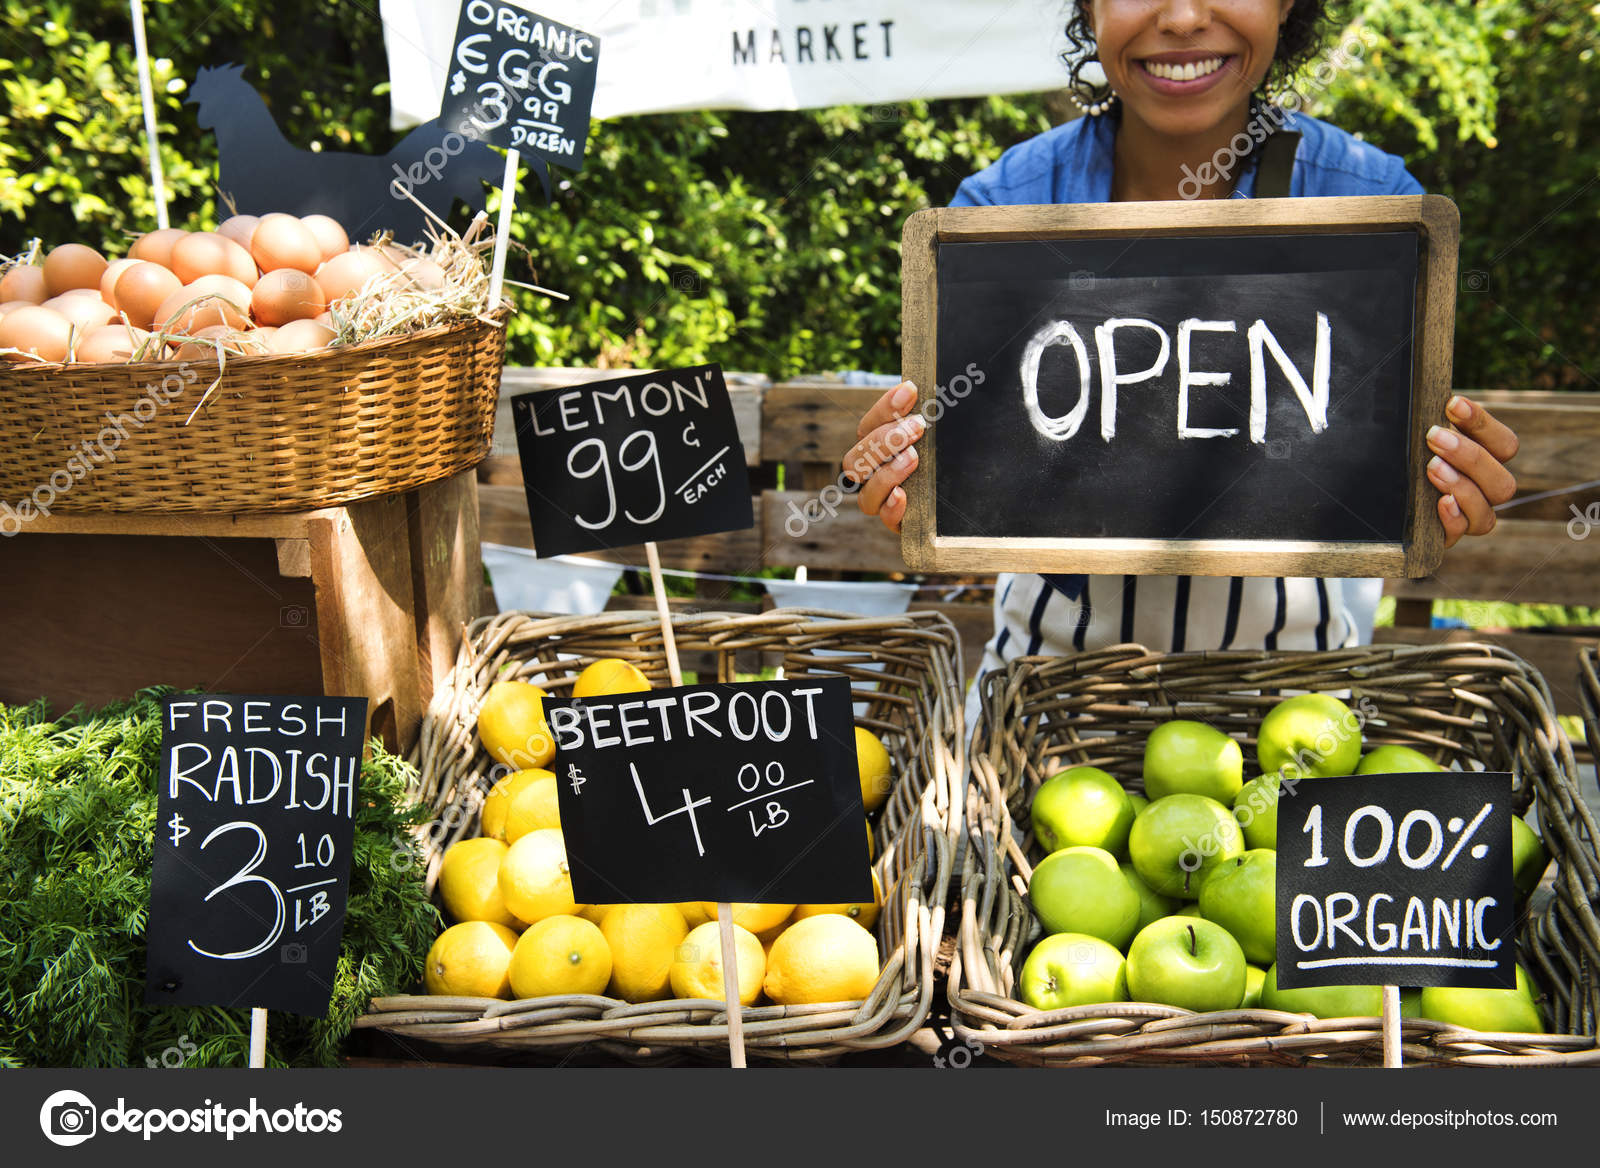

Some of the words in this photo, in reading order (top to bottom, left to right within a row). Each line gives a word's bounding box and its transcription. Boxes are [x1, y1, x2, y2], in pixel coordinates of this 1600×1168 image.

[467, 0, 593, 62] ORGANIC
[732, 19, 895, 66] MARKET
[457, 33, 572, 104] EGG
[523, 97, 559, 123] 99
[510, 126, 576, 155] DOZEN
[1020, 311, 1332, 444] OPEN
[683, 463, 727, 504] EACH
[169, 700, 346, 737] FRESH
[550, 688, 823, 751] BEETROOT
[168, 742, 356, 819] RADISH
[629, 762, 712, 857] 4
[748, 801, 790, 837] LB
[294, 832, 335, 869] 10
[1302, 803, 1493, 872] 100%
[294, 890, 331, 932] LB
[1291, 892, 1502, 952] ORGANIC
